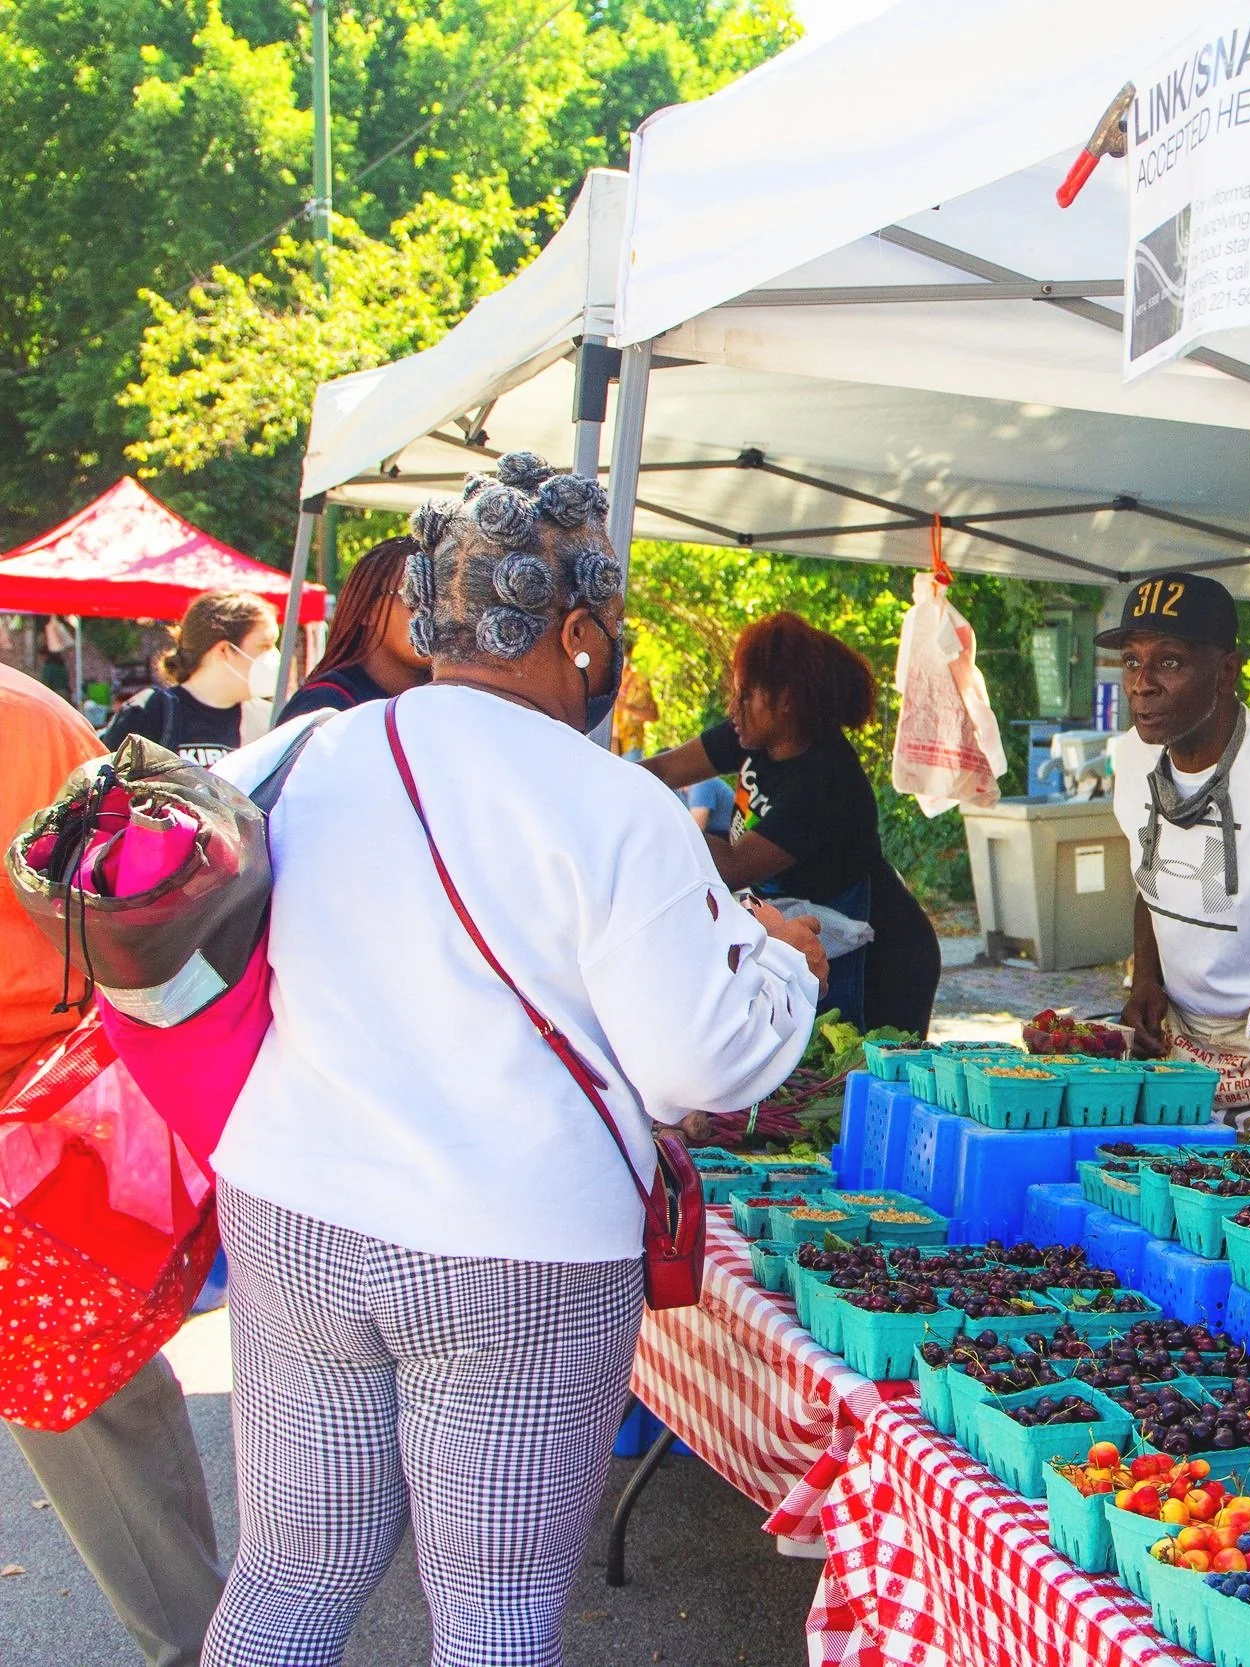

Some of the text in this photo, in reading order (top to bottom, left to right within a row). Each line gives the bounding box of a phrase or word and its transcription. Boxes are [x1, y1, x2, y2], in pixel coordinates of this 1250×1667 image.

[1137, 108, 1211, 193] ACCEPTED
[1226, 260, 1250, 282] call
[1133, 579, 1185, 617] 312
[1174, 1035, 1215, 1064] GRANT
[1219, 1081, 1232, 1092] AT
